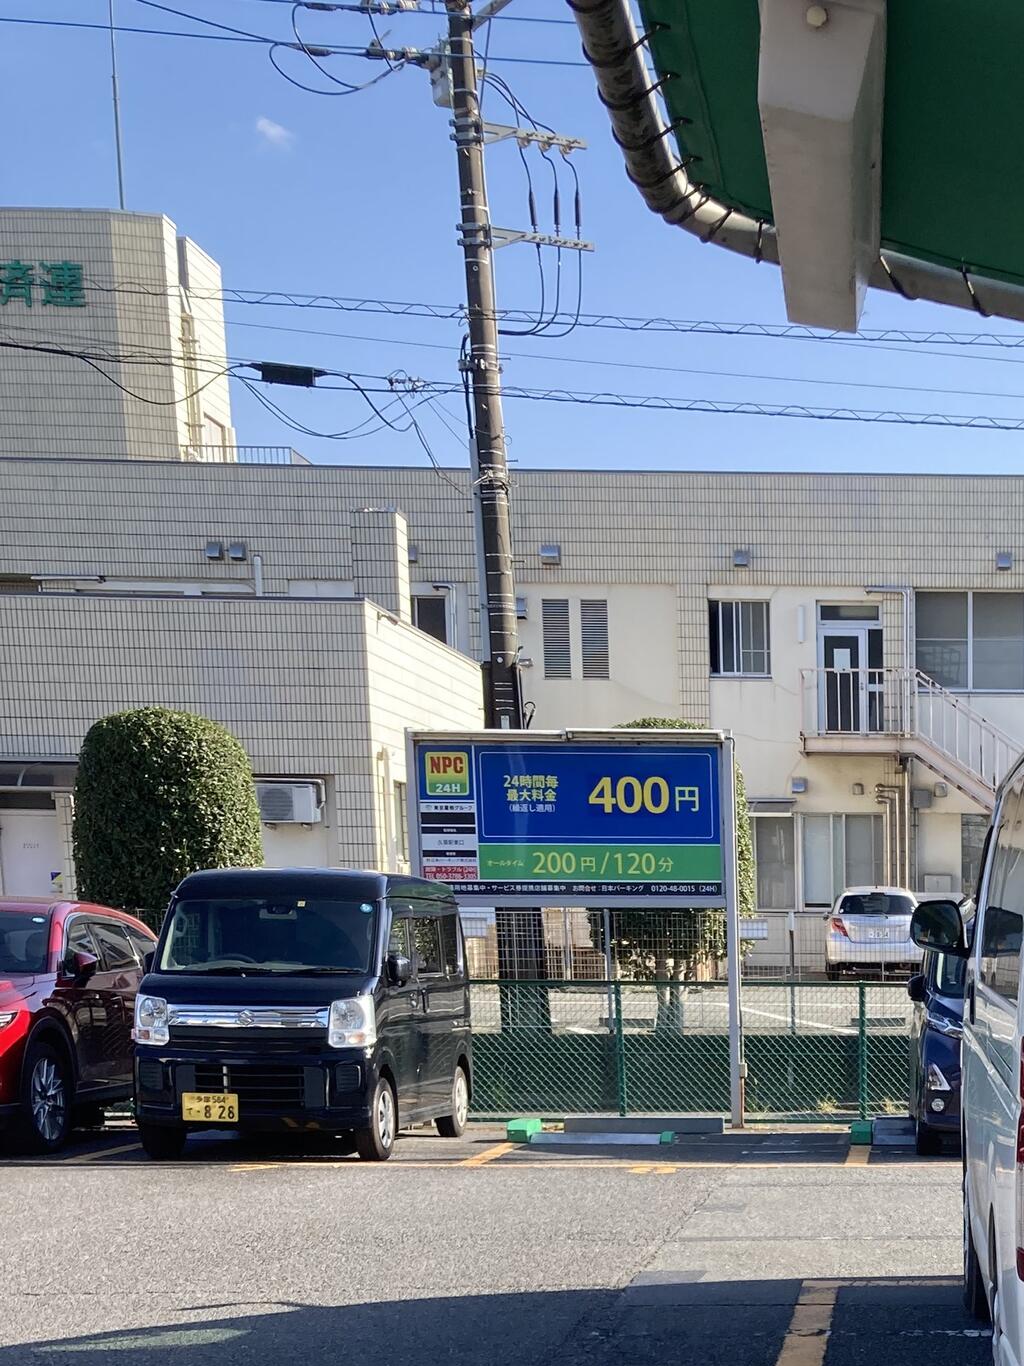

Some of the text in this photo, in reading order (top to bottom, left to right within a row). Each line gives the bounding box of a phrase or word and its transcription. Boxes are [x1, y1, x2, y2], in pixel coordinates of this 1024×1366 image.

[430, 756, 464, 774] NPC
[435, 783, 461, 793] 24H
[503, 775, 559, 788] 24時間毎
[506, 789, 557, 802] 最大料金
[588, 776, 699, 814] 400円
